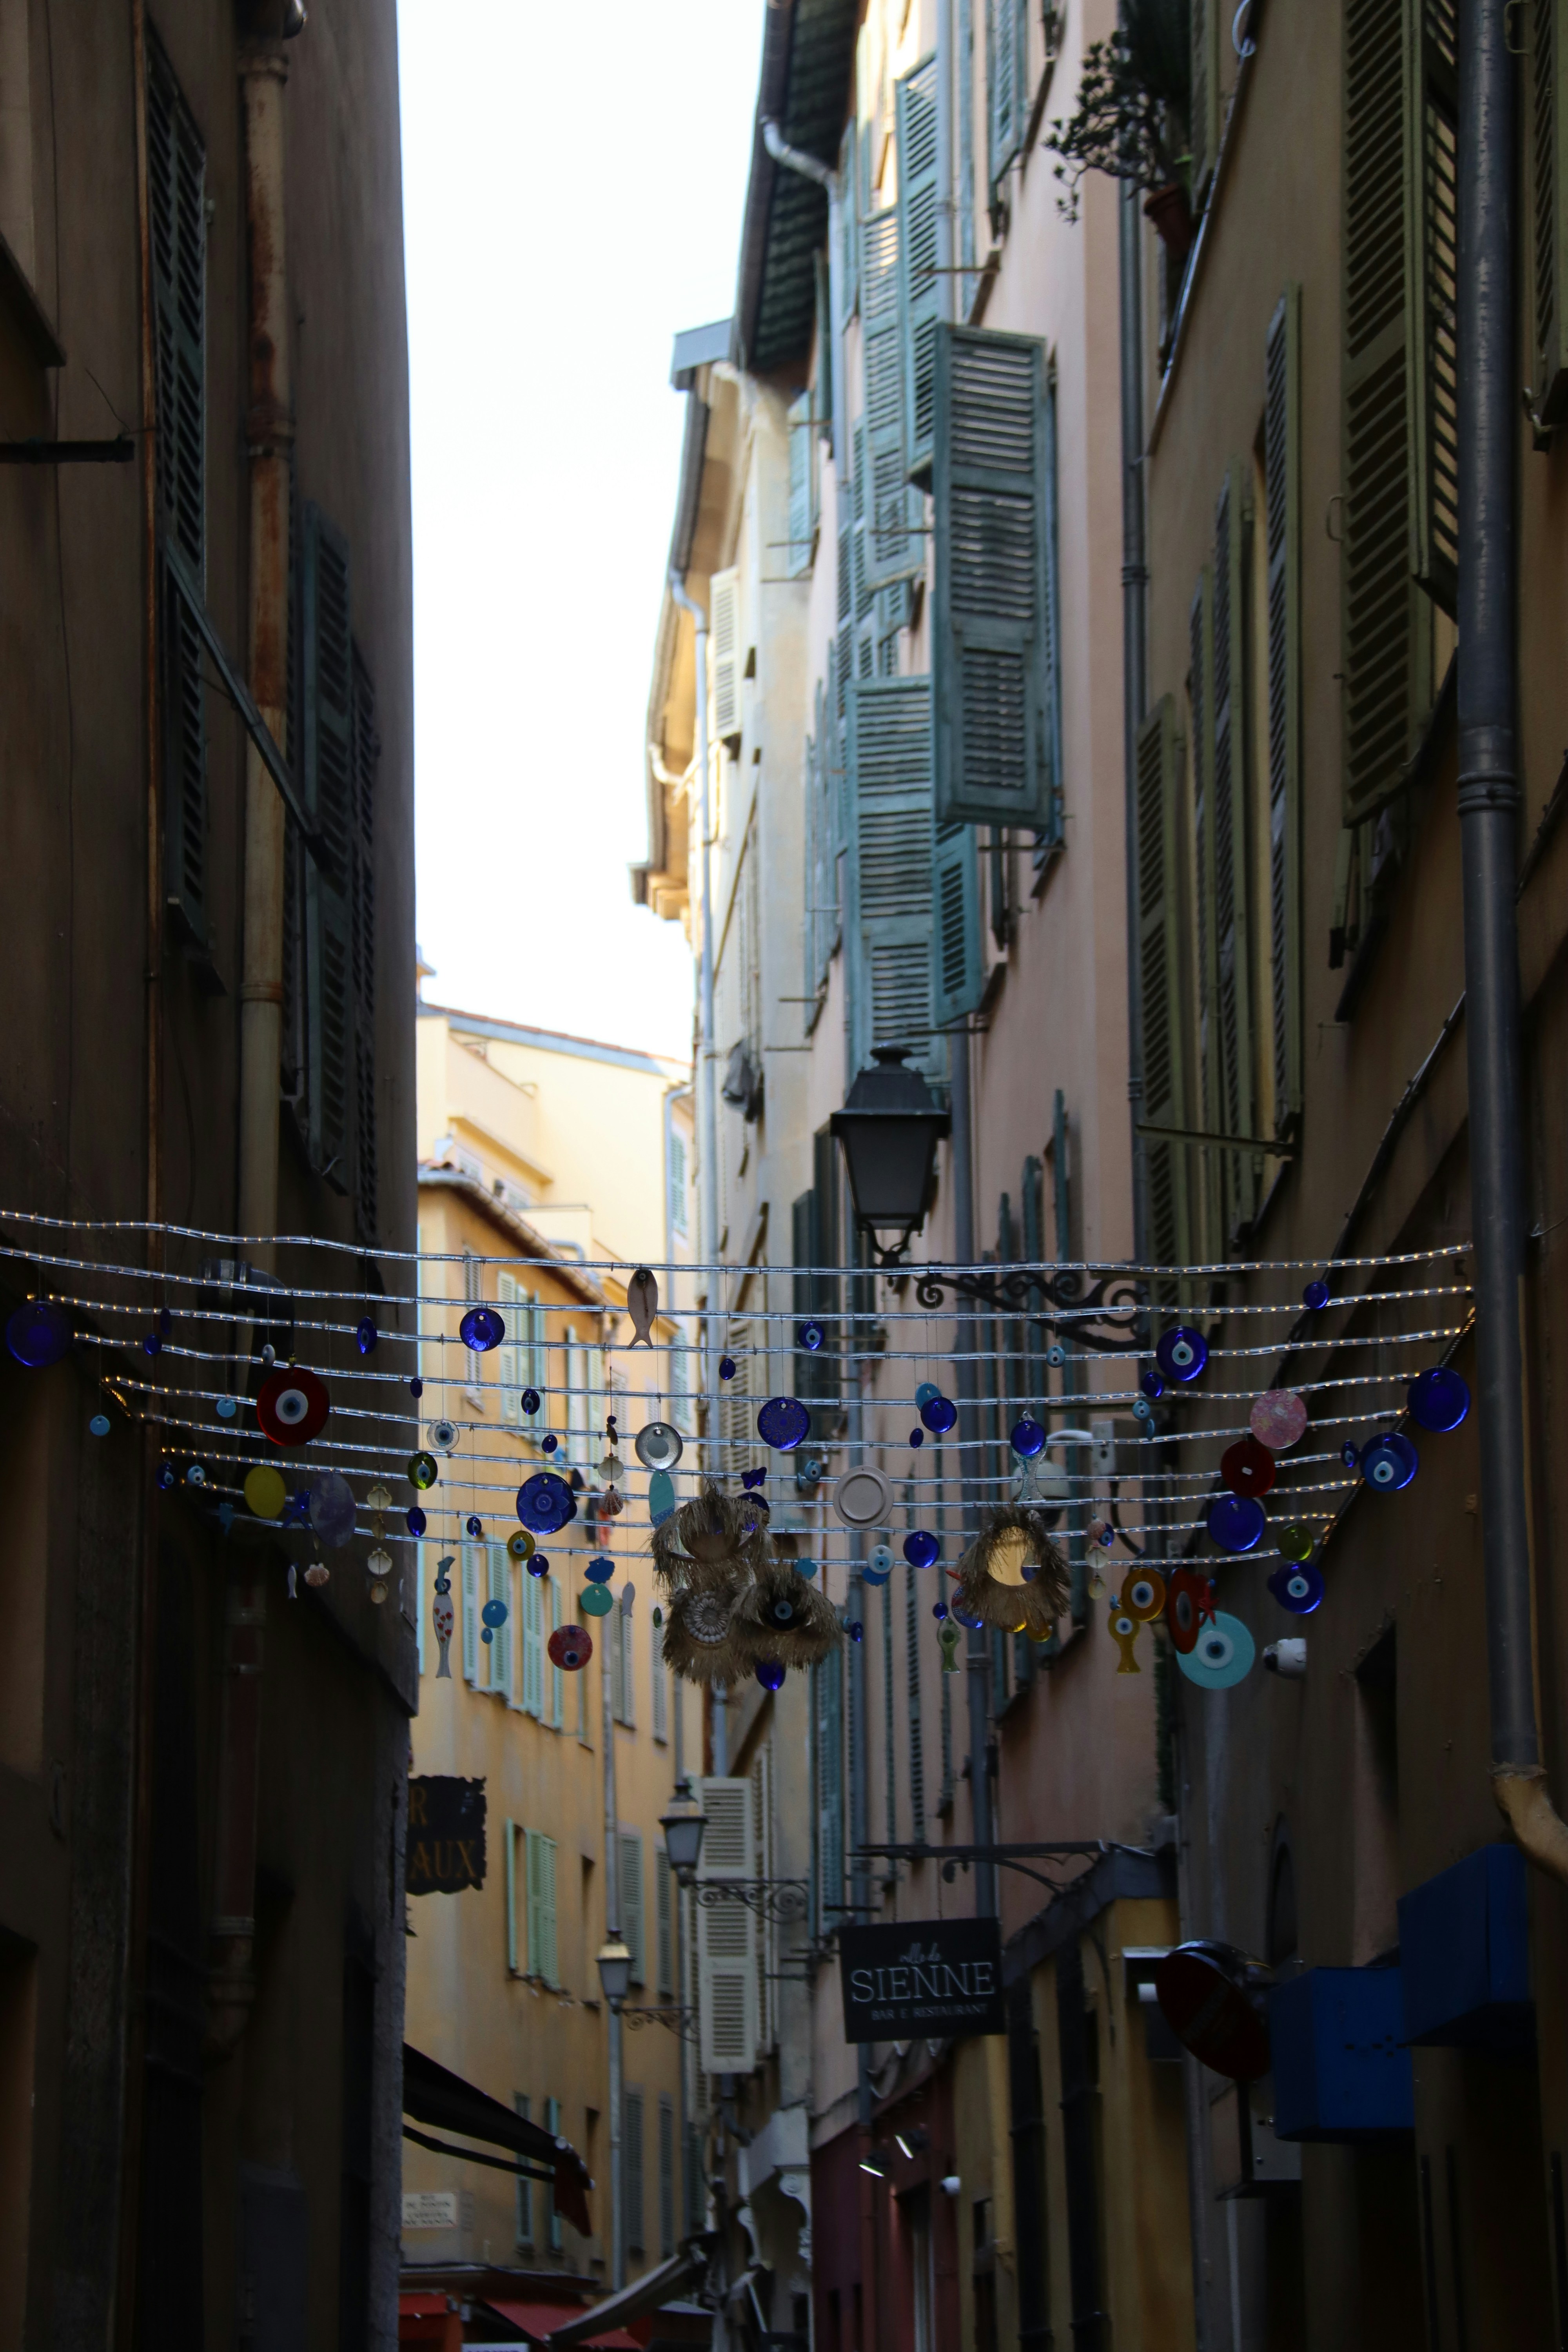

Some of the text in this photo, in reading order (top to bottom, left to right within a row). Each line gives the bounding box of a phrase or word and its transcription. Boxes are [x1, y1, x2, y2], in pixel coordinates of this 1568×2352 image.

[408, 1839, 477, 1880] AUX
[850, 1962, 996, 2002] SIENNE
[871, 2008, 895, 2020] BAR
[913, 2004, 988, 2018] RESTAURANT
